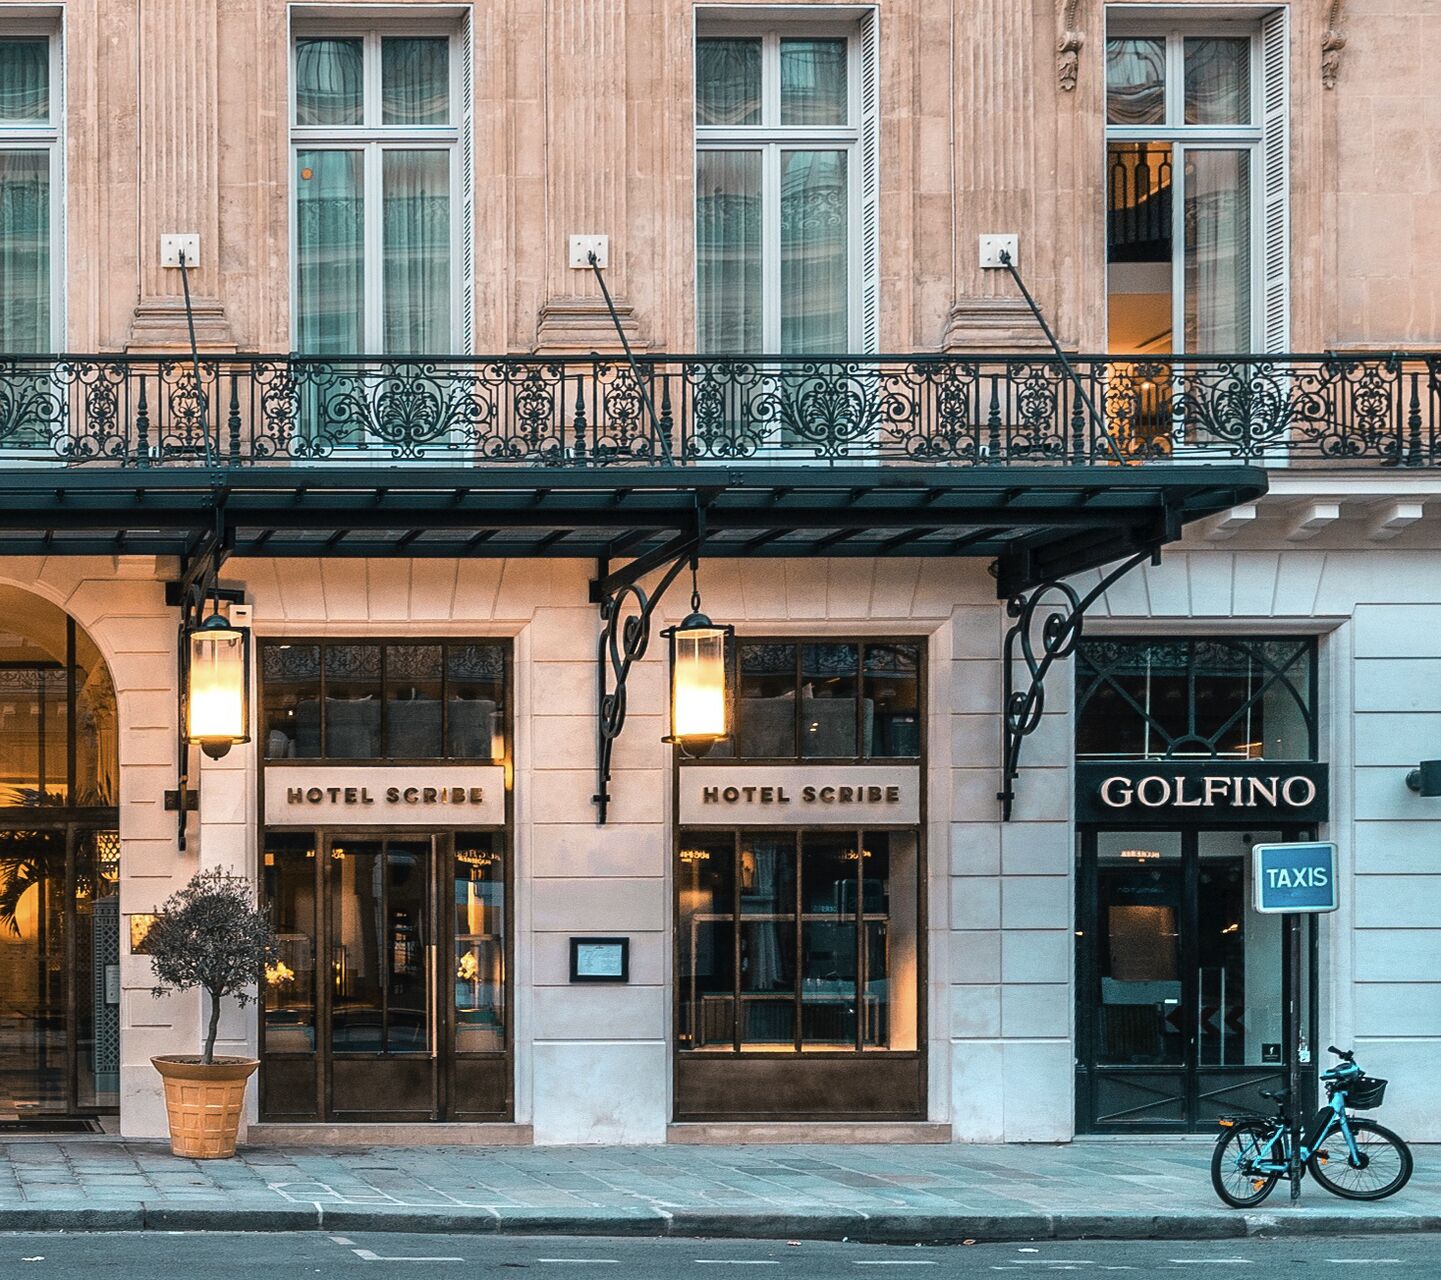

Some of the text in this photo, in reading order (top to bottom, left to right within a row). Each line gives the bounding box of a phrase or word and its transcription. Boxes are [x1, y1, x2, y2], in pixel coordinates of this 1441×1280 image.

[287, 787, 483, 804] HOTEL SCRIBE
[703, 786, 900, 803] HOTEL SCRIBE
[1100, 776, 1317, 808] GOLFINO
[1267, 867, 1328, 889] TAXIS
